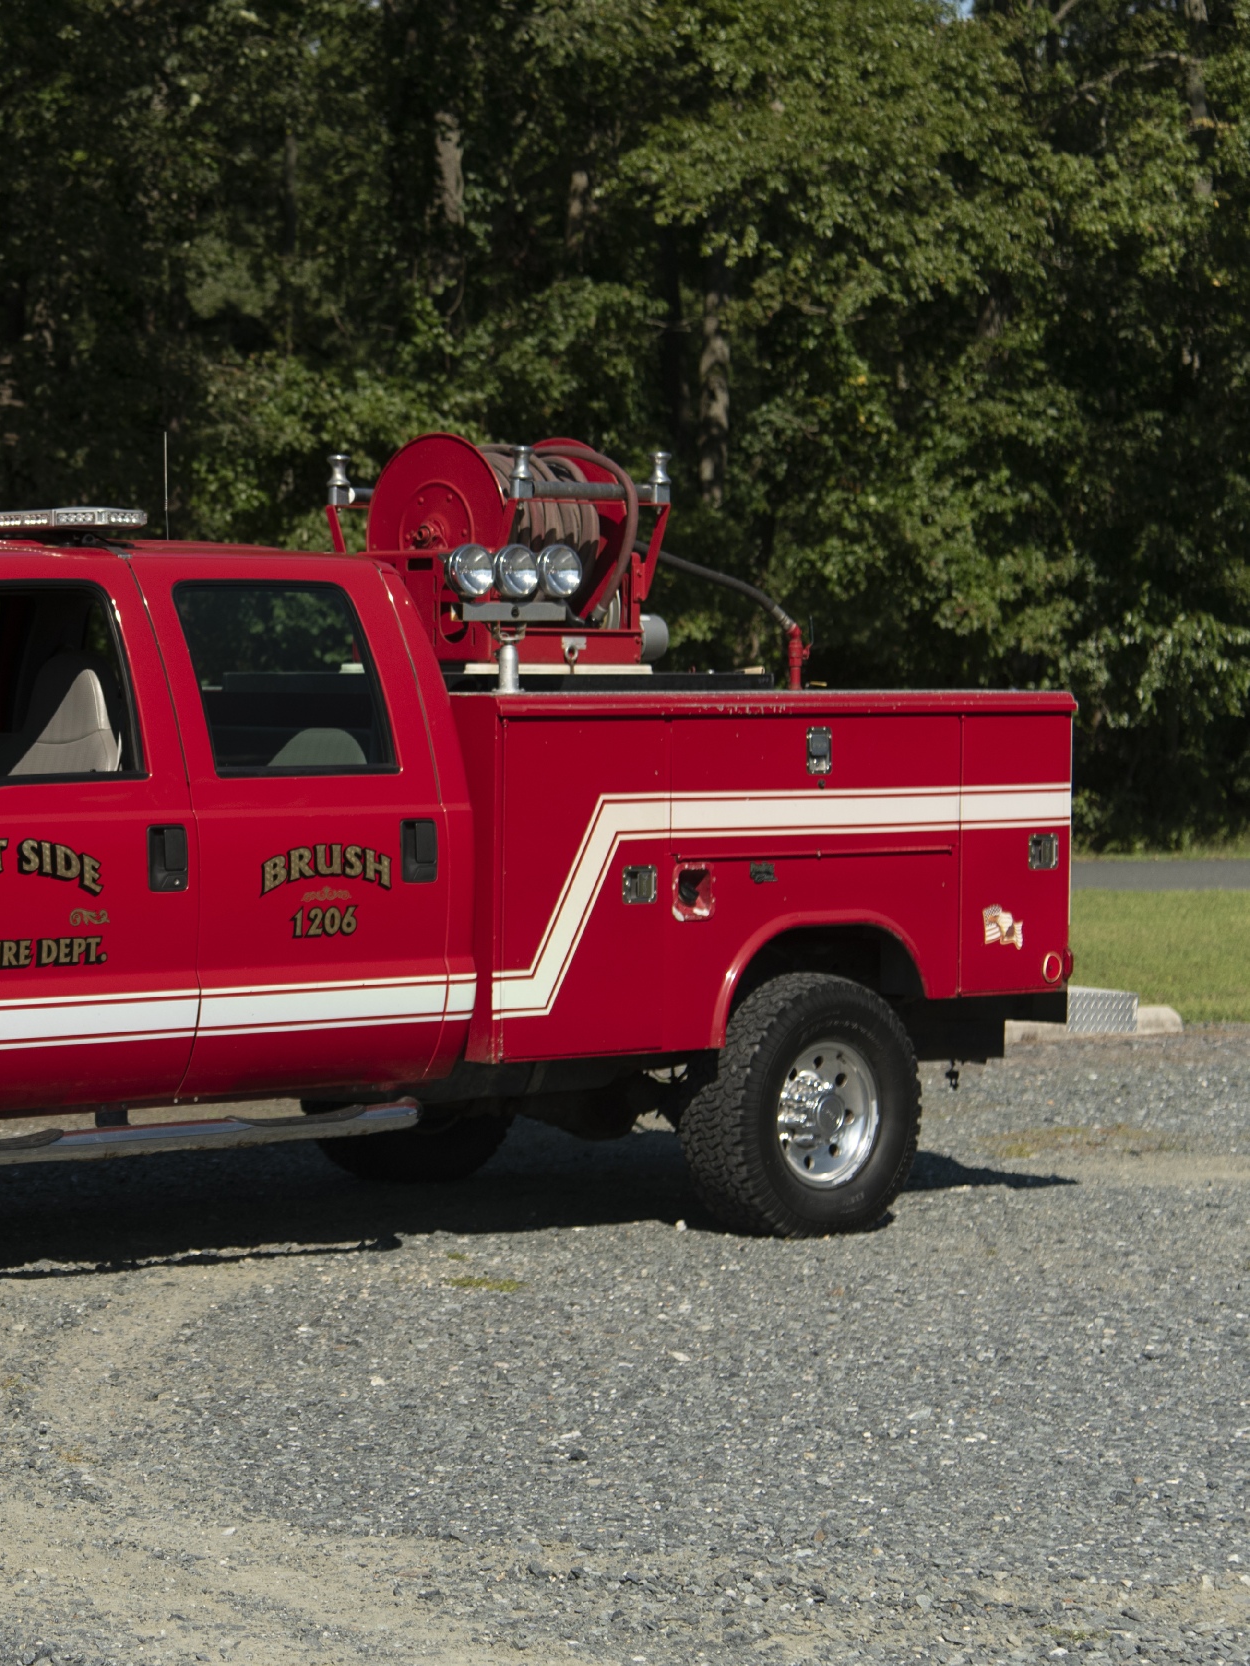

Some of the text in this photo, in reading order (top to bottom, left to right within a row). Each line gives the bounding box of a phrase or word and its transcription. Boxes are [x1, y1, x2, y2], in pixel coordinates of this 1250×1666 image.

[17, 838, 105, 896] SIDE
[260, 843, 392, 898] BRUSH
[289, 904, 359, 939] 1206
[35, 936, 108, 967] DEPT.
